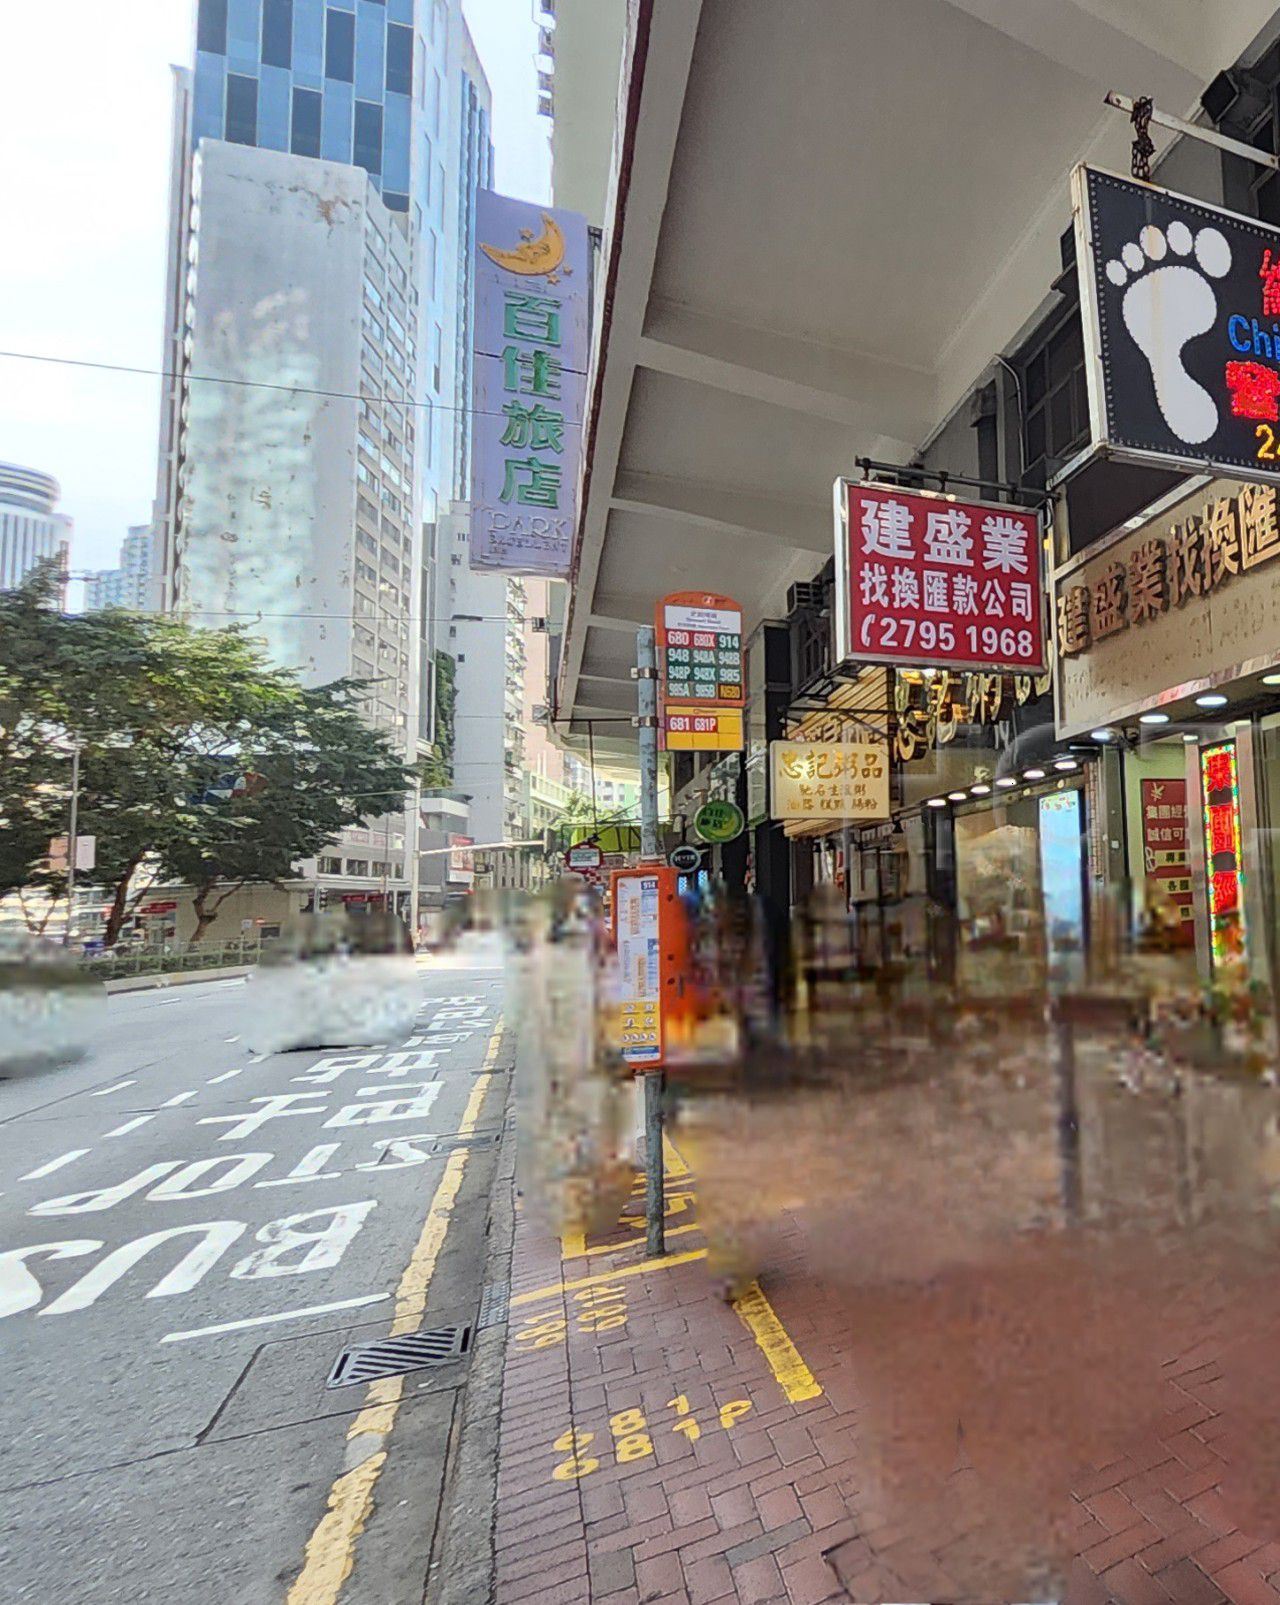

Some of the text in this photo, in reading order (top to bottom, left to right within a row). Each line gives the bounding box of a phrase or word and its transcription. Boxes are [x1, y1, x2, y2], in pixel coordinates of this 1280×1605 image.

[860, 499, 1029, 574] 建盛業
[860, 562, 1032, 622] 找換匯款公司
[668, 632, 689, 645] 680
[719, 635, 739, 648] 914
[880, 617, 1033, 657] 2795 1968
[668, 648, 689, 662] 948
[719, 669, 740, 682] 985
[669, 718, 717, 732] 681 681P
[1147, 828, 1189, 841] 誠信可
[26, 1134, 438, 1217] STOP
[0, 1200, 378, 1319] BUS
